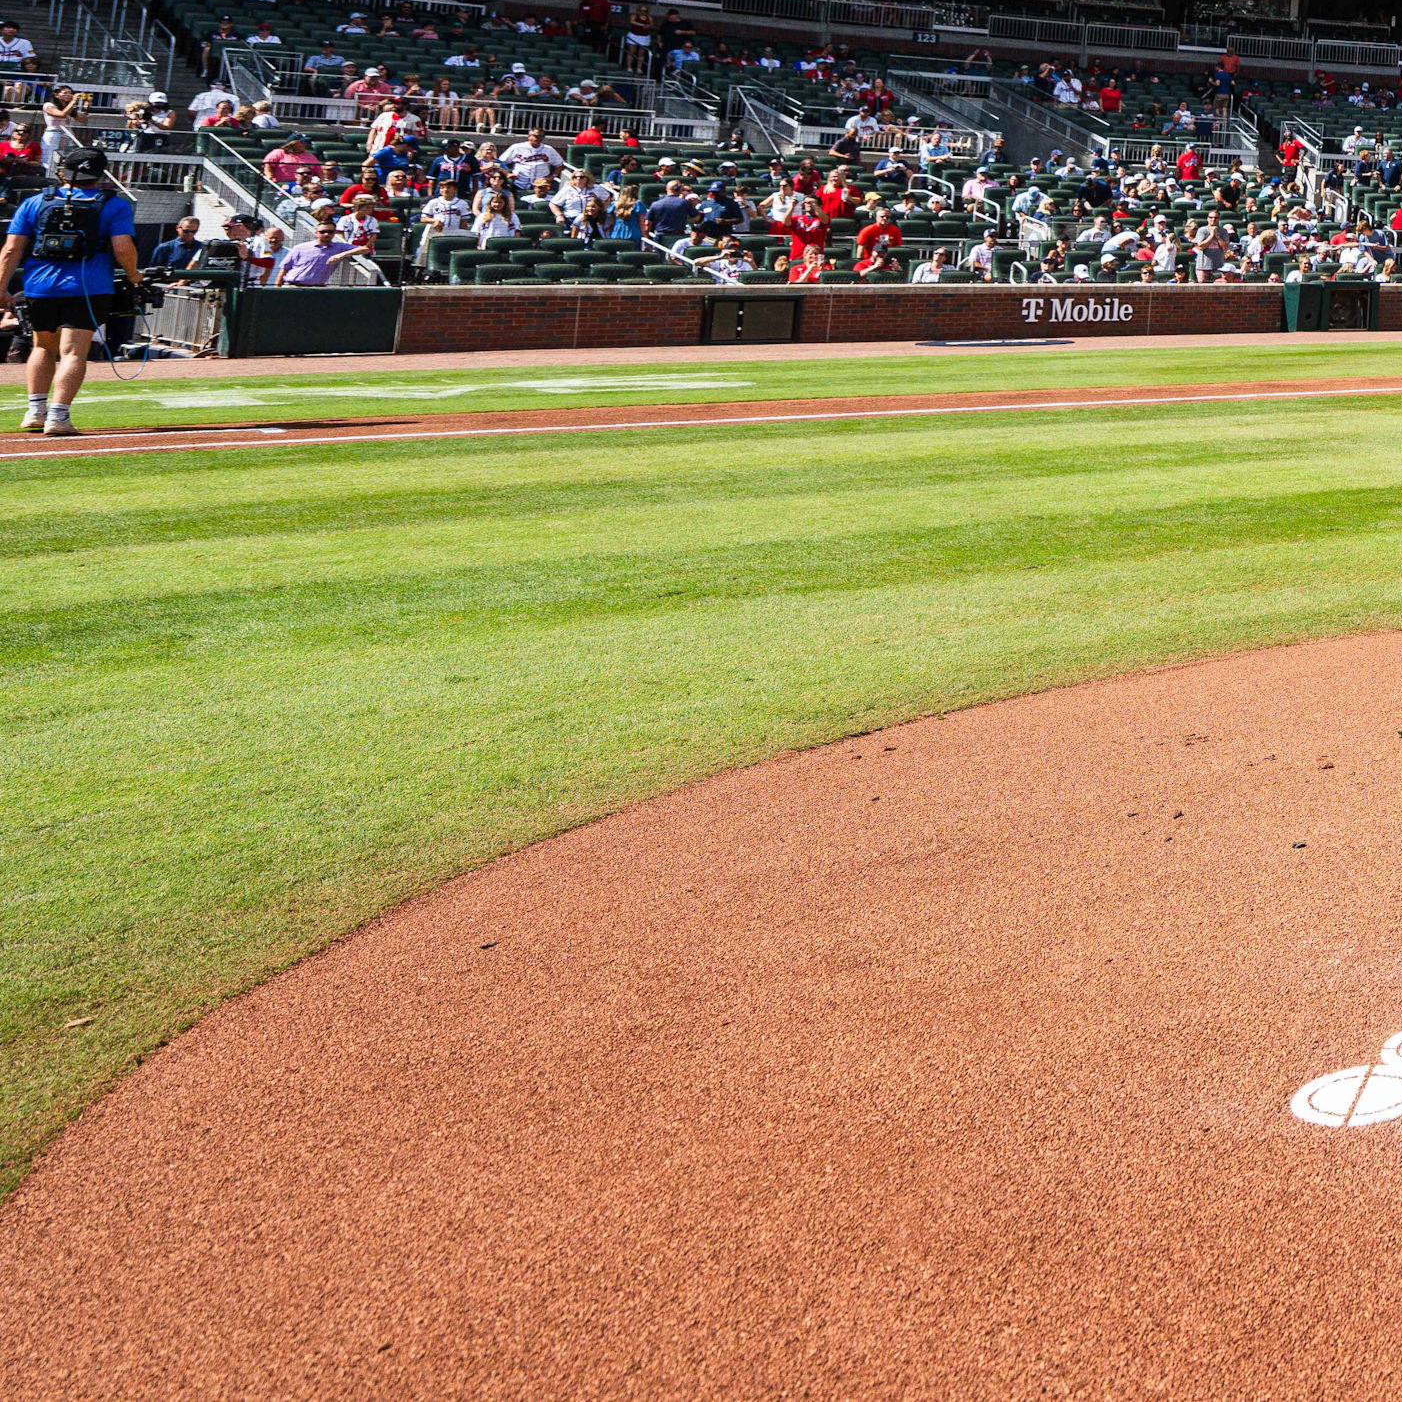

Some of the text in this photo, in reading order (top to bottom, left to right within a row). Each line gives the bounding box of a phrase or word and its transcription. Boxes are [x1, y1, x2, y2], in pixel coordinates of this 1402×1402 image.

[916, 33, 936, 43] 123
[101, 131, 123, 139] 120
[1049, 298, 1134, 322] Mobile
